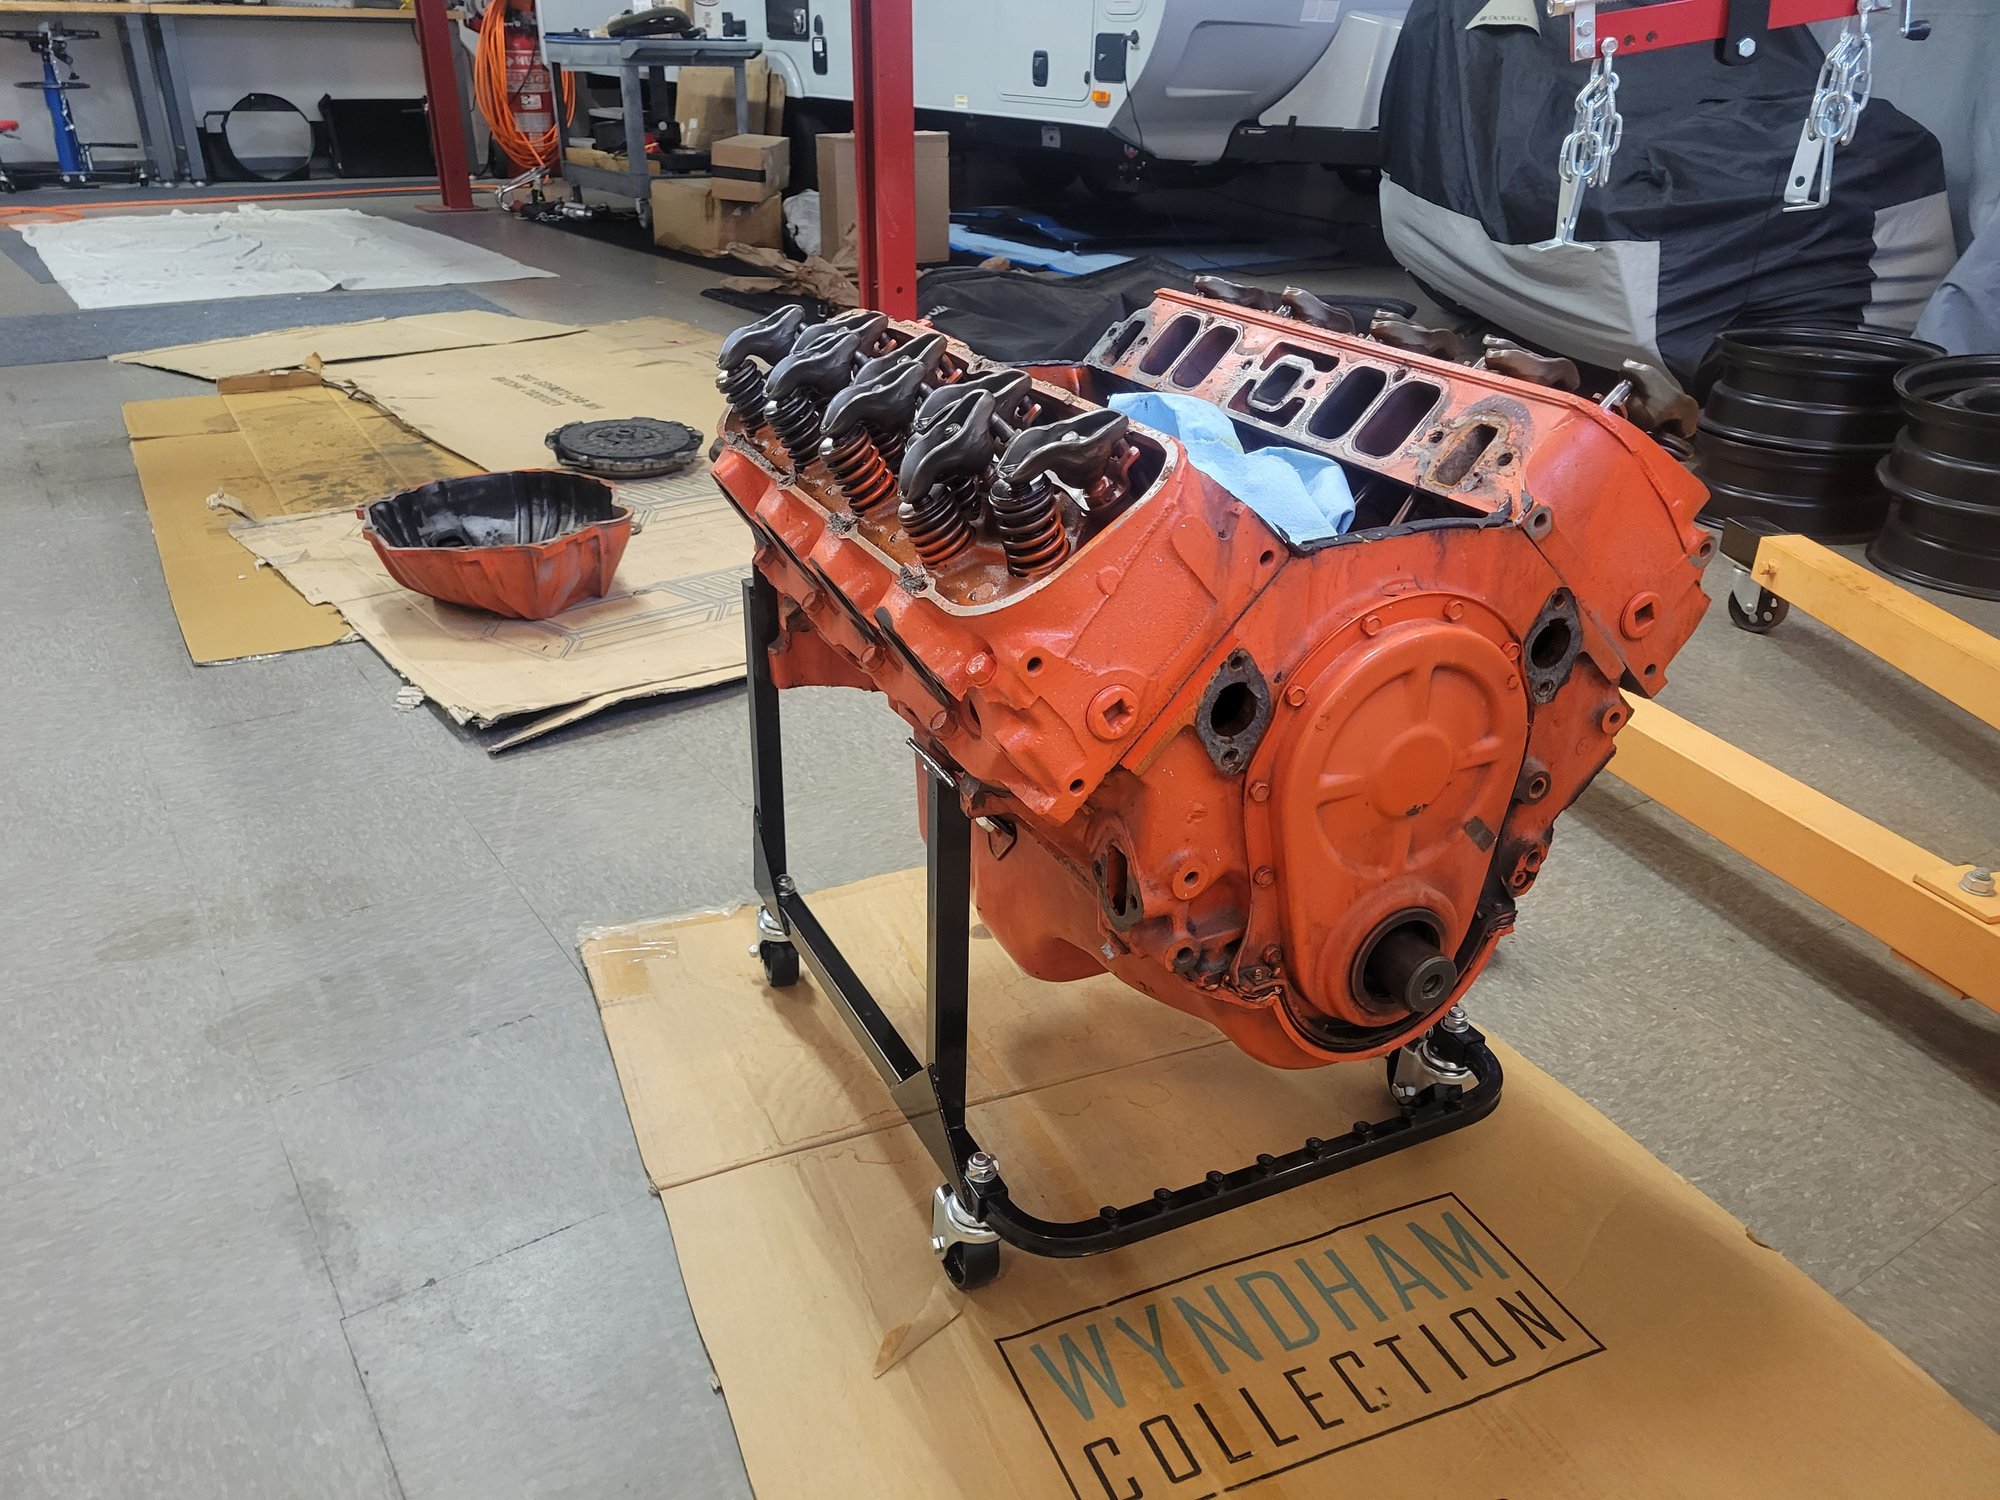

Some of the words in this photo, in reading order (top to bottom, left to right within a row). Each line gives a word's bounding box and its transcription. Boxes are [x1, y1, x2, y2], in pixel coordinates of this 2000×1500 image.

[515, 55, 542, 65] HUS
[1030, 1211, 1510, 1421] WYNDHAM
[1083, 1290, 1566, 1500] COLLECTION
